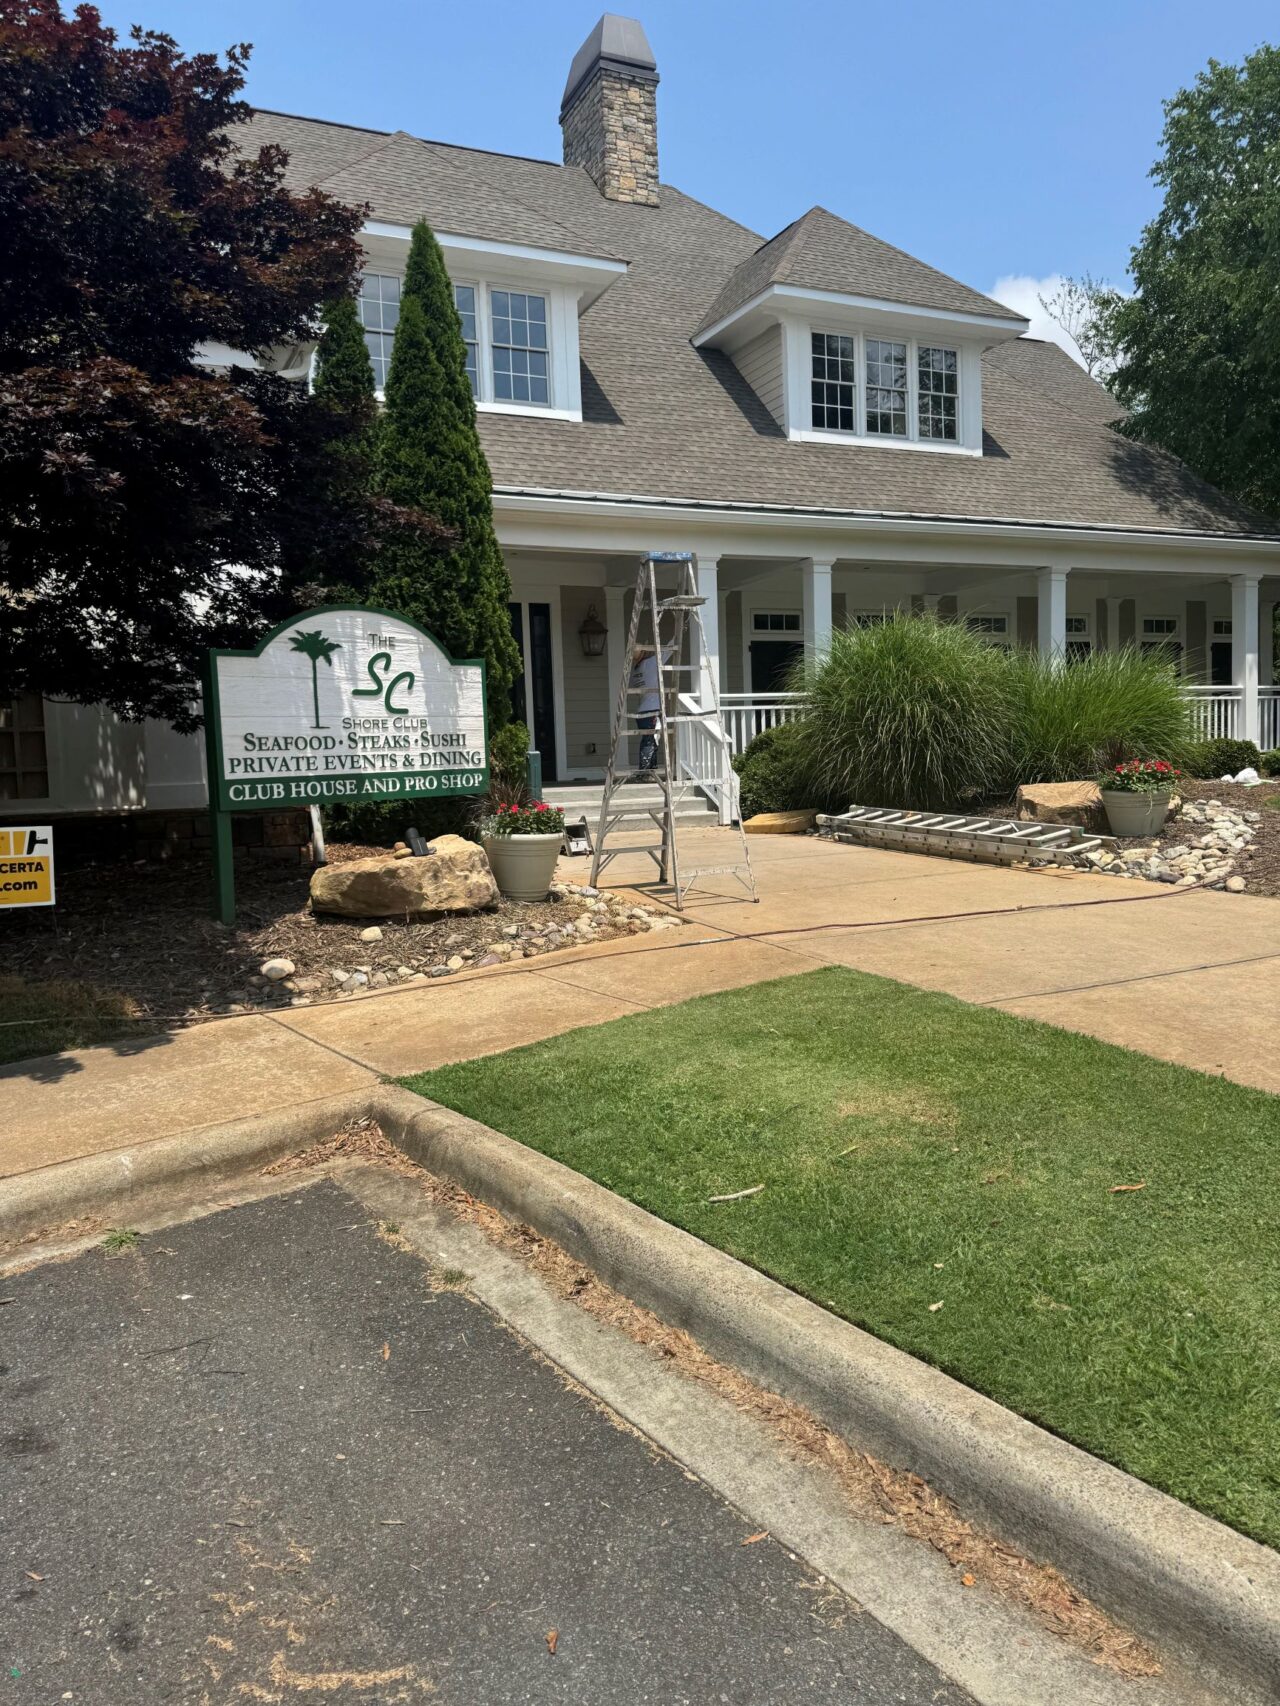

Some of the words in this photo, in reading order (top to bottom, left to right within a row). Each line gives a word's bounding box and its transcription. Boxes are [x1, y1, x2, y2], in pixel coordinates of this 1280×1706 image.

[369, 633, 395, 647] THE
[352, 652, 415, 714] SC
[342, 718, 388, 729] SHORE
[393, 718, 428, 729] CLUB
[229, 757, 318, 774] PRIVATE
[324, 754, 397, 770] EVENTS
[403, 755, 414, 767] &
[420, 751, 481, 766] DINING
[229, 783, 285, 801] CLUB
[290, 781, 356, 796] HOUSE
[362, 779, 400, 793] AND
[405, 776, 437, 790] PRO
[442, 773, 483, 788] SHOP
